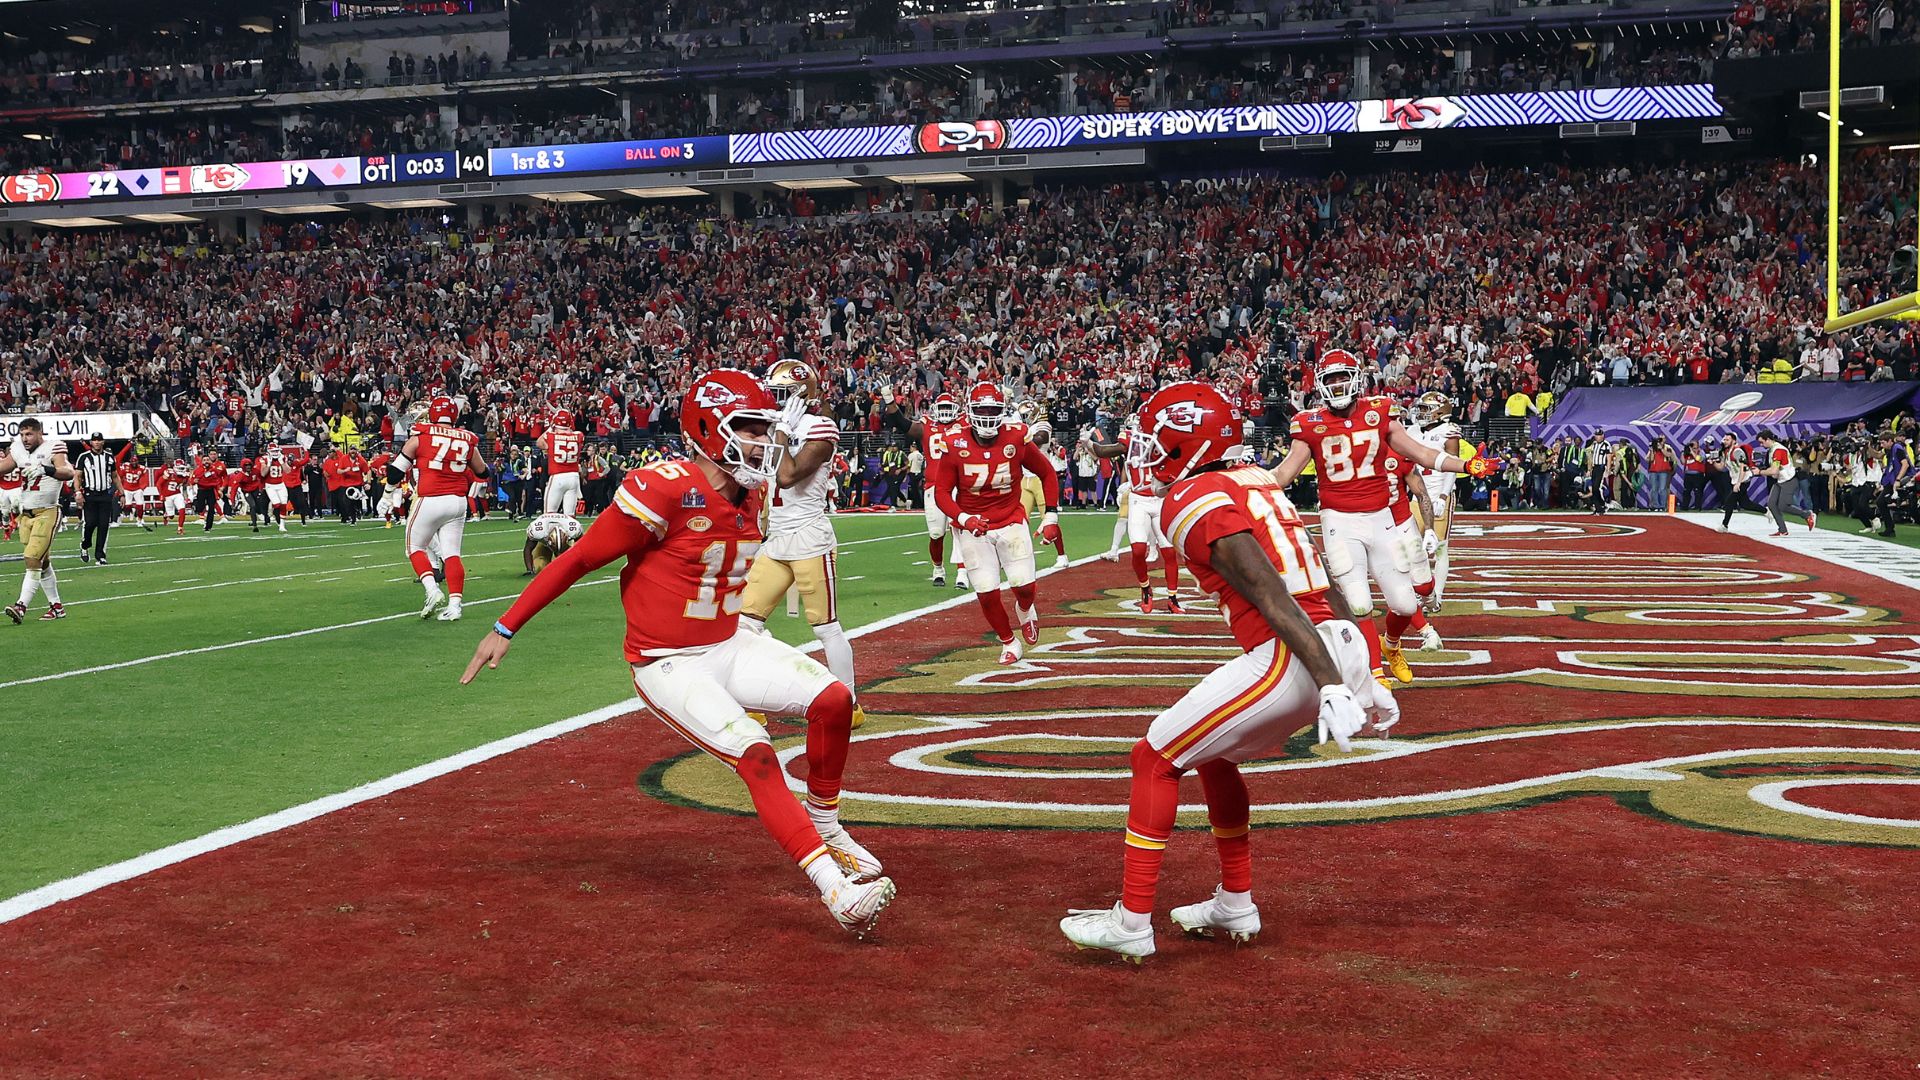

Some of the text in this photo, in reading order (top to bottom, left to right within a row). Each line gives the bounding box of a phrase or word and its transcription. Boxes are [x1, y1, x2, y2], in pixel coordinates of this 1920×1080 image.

[1083, 111, 1278, 138] SUPER BOWL LVIII
[1704, 129, 1719, 137] 139
[367, 156, 385, 165] QTR
[511, 150, 565, 170] 1ST & 3
[625, 143, 695, 160] BALL ON 3
[281, 162, 309, 186] 19
[364, 164, 390, 182] OT
[406, 157, 445, 175] 0:03
[462, 155, 485, 172] 40
[15, 174, 50, 202] SF
[87, 173, 119, 196] 22
[205, 166, 236, 189] KC
[0, 419, 89, 437] BOL LVIII
[428, 435, 471, 473] 73
[554, 440, 579, 464] 52
[1321, 429, 1380, 482] 87
[269, 466, 283, 478] 81
[963, 461, 1013, 496] 74
[683, 540, 763, 620] 15
